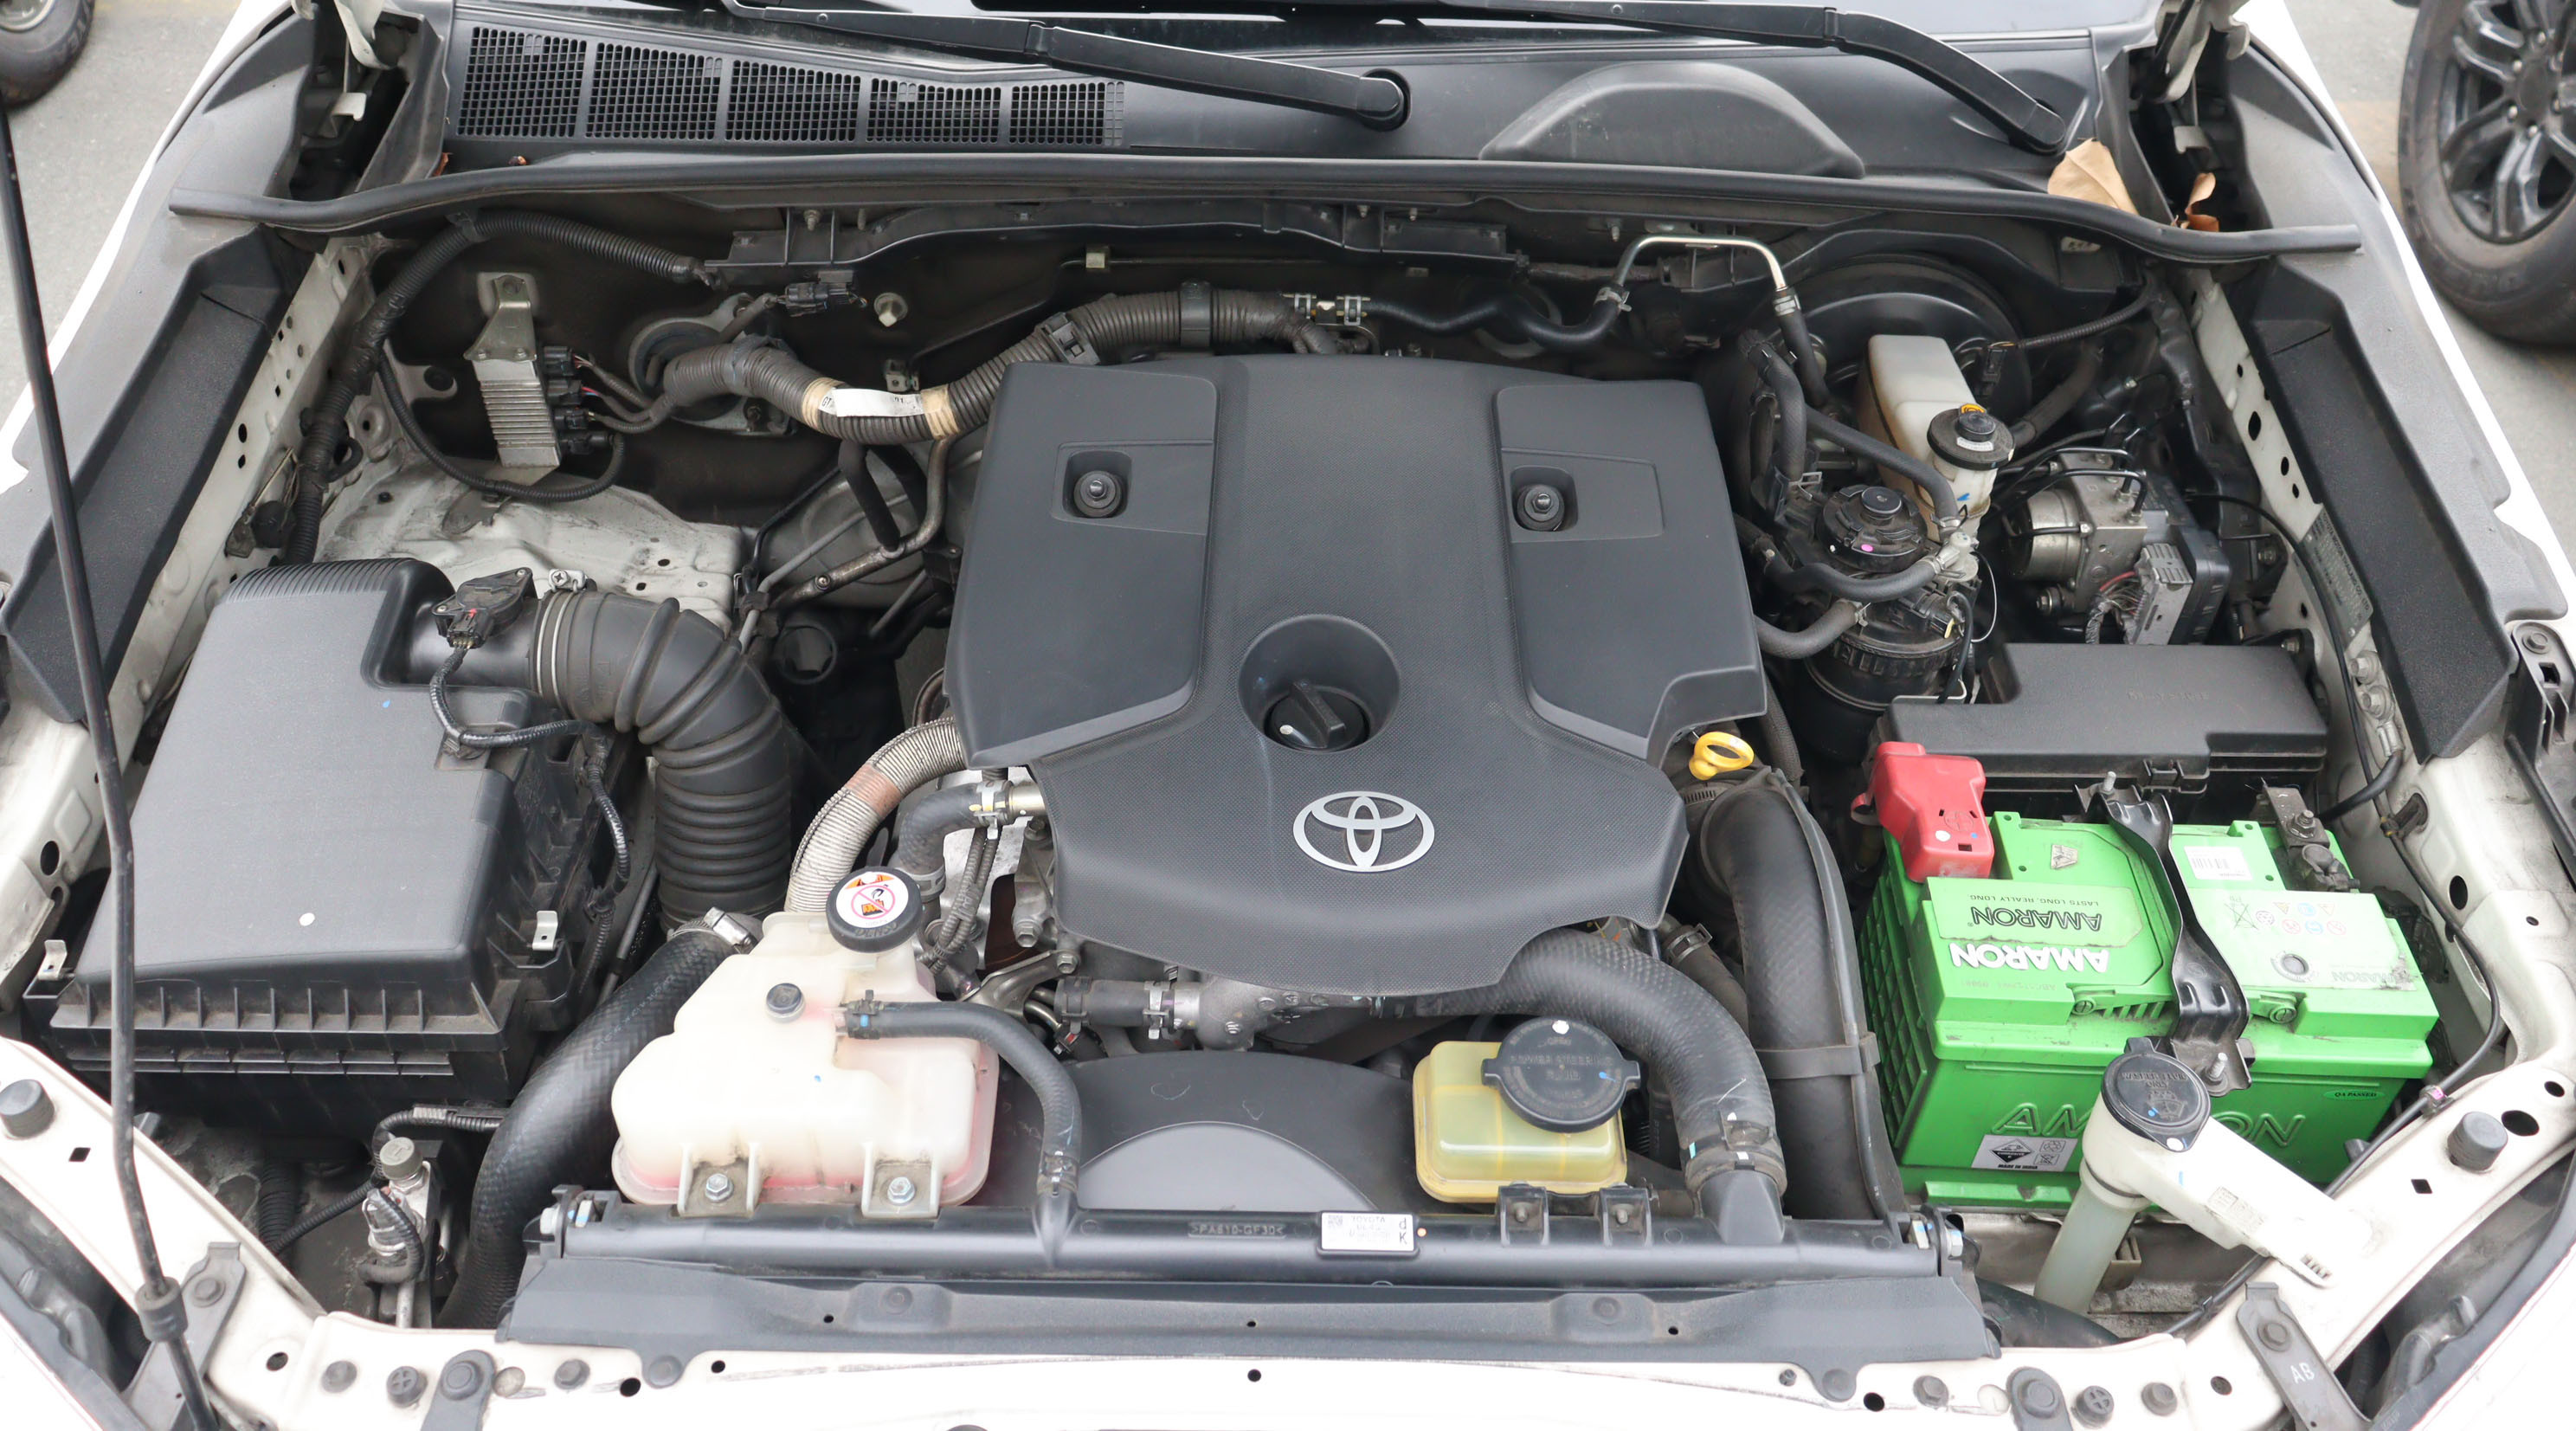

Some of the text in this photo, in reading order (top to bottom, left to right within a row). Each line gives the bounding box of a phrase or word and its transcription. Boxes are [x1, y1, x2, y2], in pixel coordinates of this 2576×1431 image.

[855, 922, 898, 938] DENSO
[1948, 943, 2110, 973] AMARON
[2122, 1072, 2160, 1080] WASHER
[1399, 1217, 1407, 1229] d
[1399, 1232, 1407, 1245] K
[2290, 1363, 2315, 1383] AB
